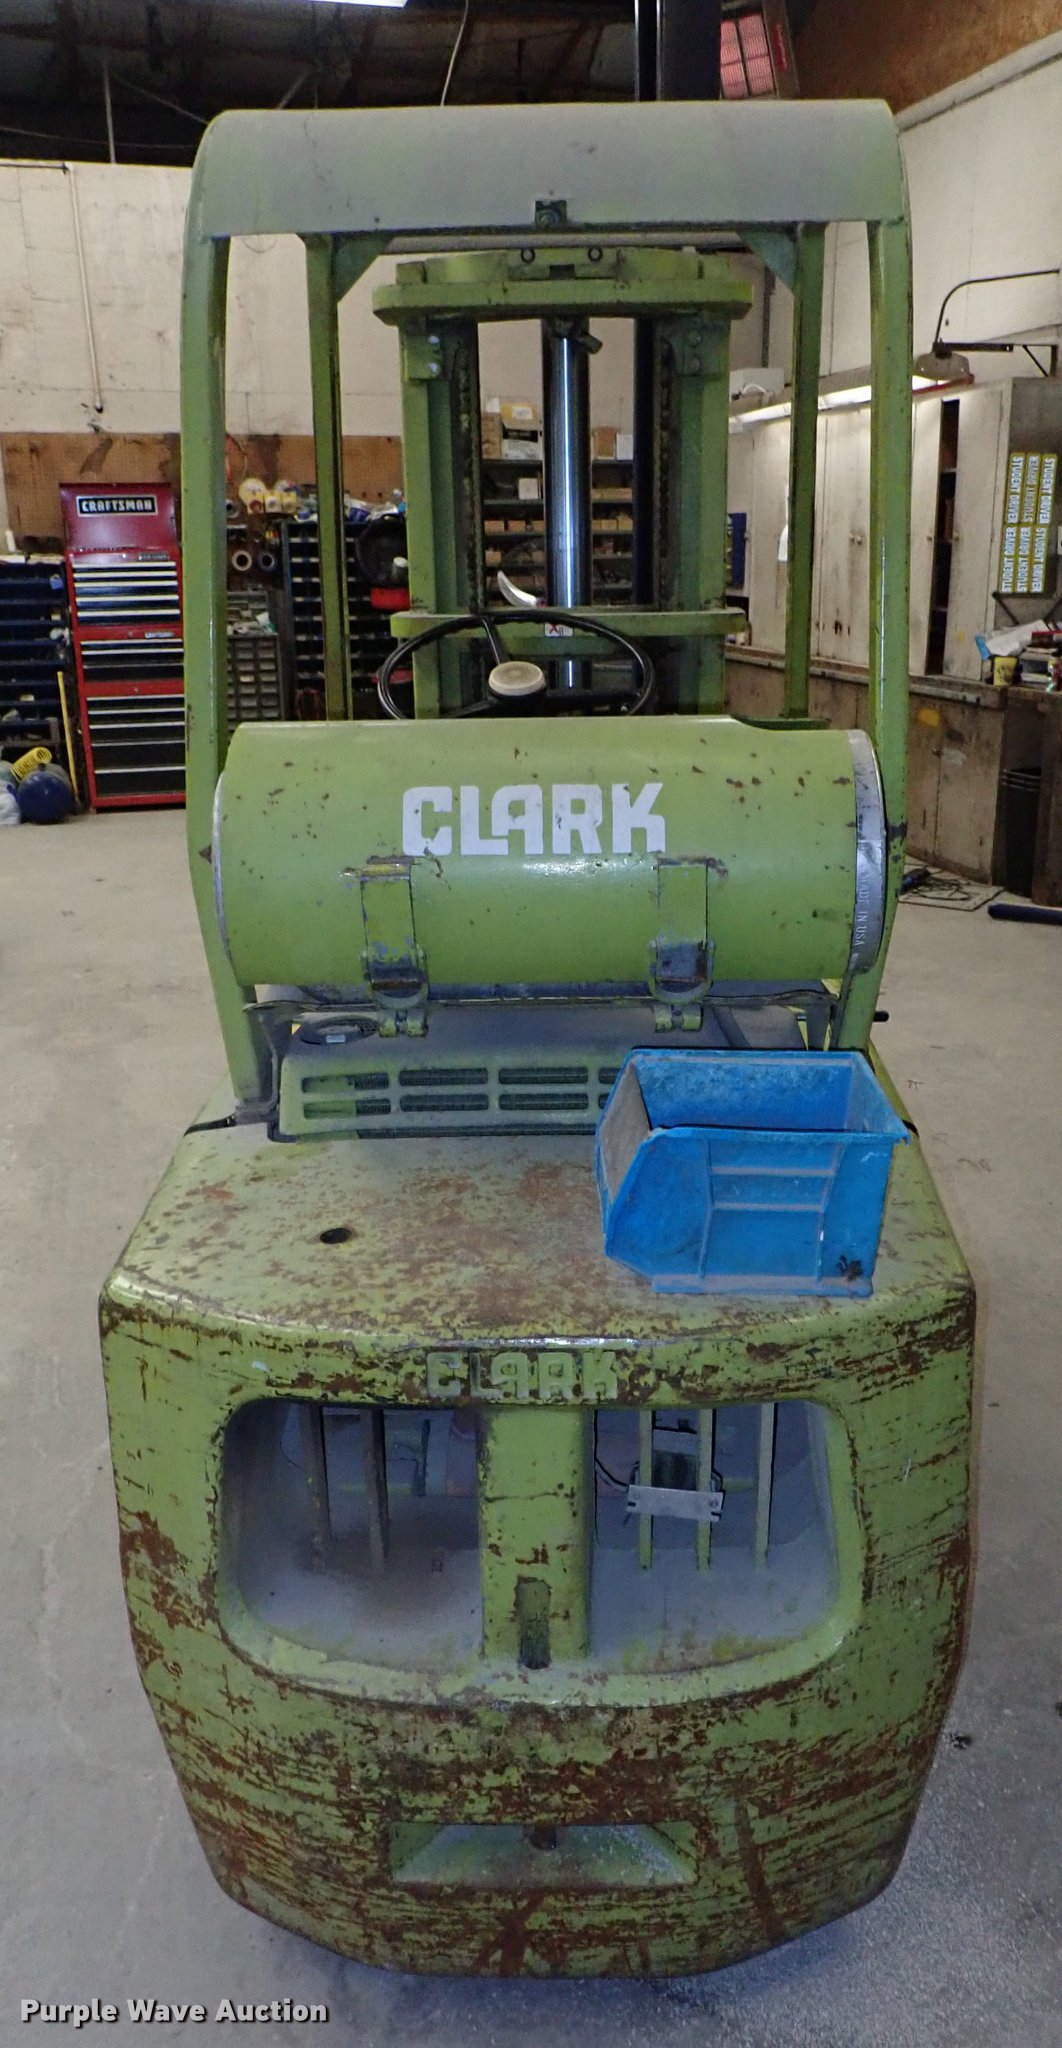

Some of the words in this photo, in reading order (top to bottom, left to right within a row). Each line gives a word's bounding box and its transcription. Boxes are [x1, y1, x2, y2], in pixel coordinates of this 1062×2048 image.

[1011, 456, 1023, 493] STUDENT
[1026, 455, 1039, 484] DRIVER
[1042, 458, 1055, 493] STUDENT
[81, 499, 153, 513] CRAFTSMAN
[1007, 494, 1019, 523] DRIVER
[1023, 487, 1036, 523] STUDENT
[1039, 495, 1051, 524] DRIVER
[1004, 526, 1017, 556] DRIVER
[1018, 526, 1031, 556] DRIVER
[1033, 527, 1046, 562] STUDENT
[1001, 557, 1014, 593] STUDENT
[1017, 557, 1029, 593] STUDENT
[1031, 563, 1043, 593] DRIVER
[402, 783, 666, 856] CLARK
[857, 911, 868, 921] IN
[854, 925, 868, 946] USA
[426, 1351, 618, 1400] CLARK
